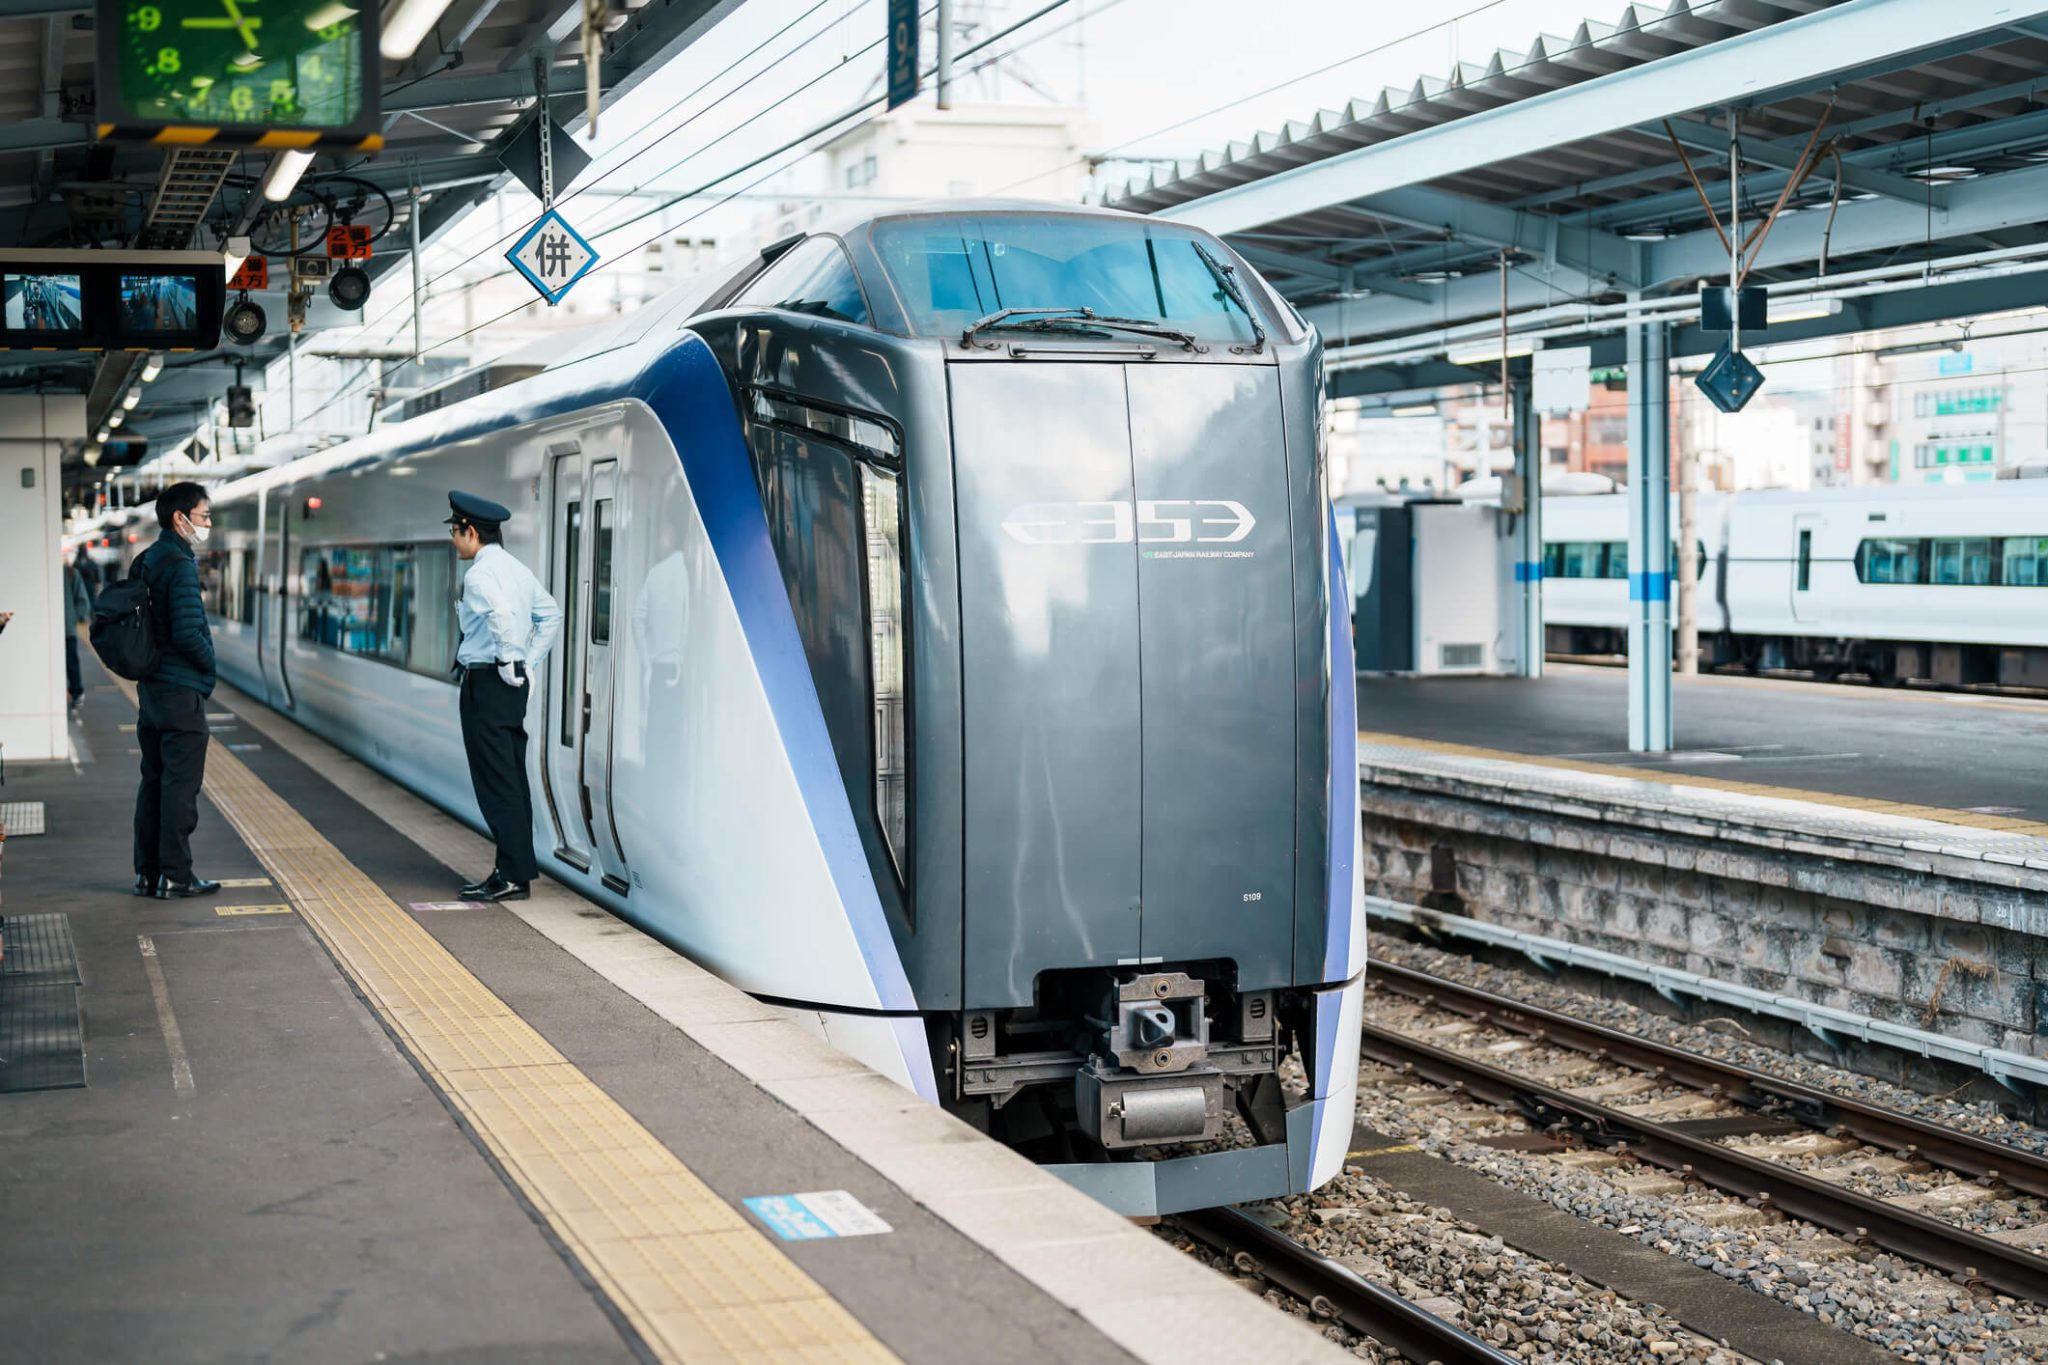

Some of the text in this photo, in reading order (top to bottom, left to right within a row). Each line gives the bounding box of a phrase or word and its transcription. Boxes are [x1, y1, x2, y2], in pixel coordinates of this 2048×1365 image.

[138, 6, 161, 31] 9
[157, 47, 181, 73] 8
[302, 54, 322, 80] 4
[230, 85, 253, 111] 6
[270, 78, 294, 103] 5
[535, 233, 572, 277] 併
[1223, 550, 1255, 558] COMPANY
[1243, 892, 1261, 902] S109
